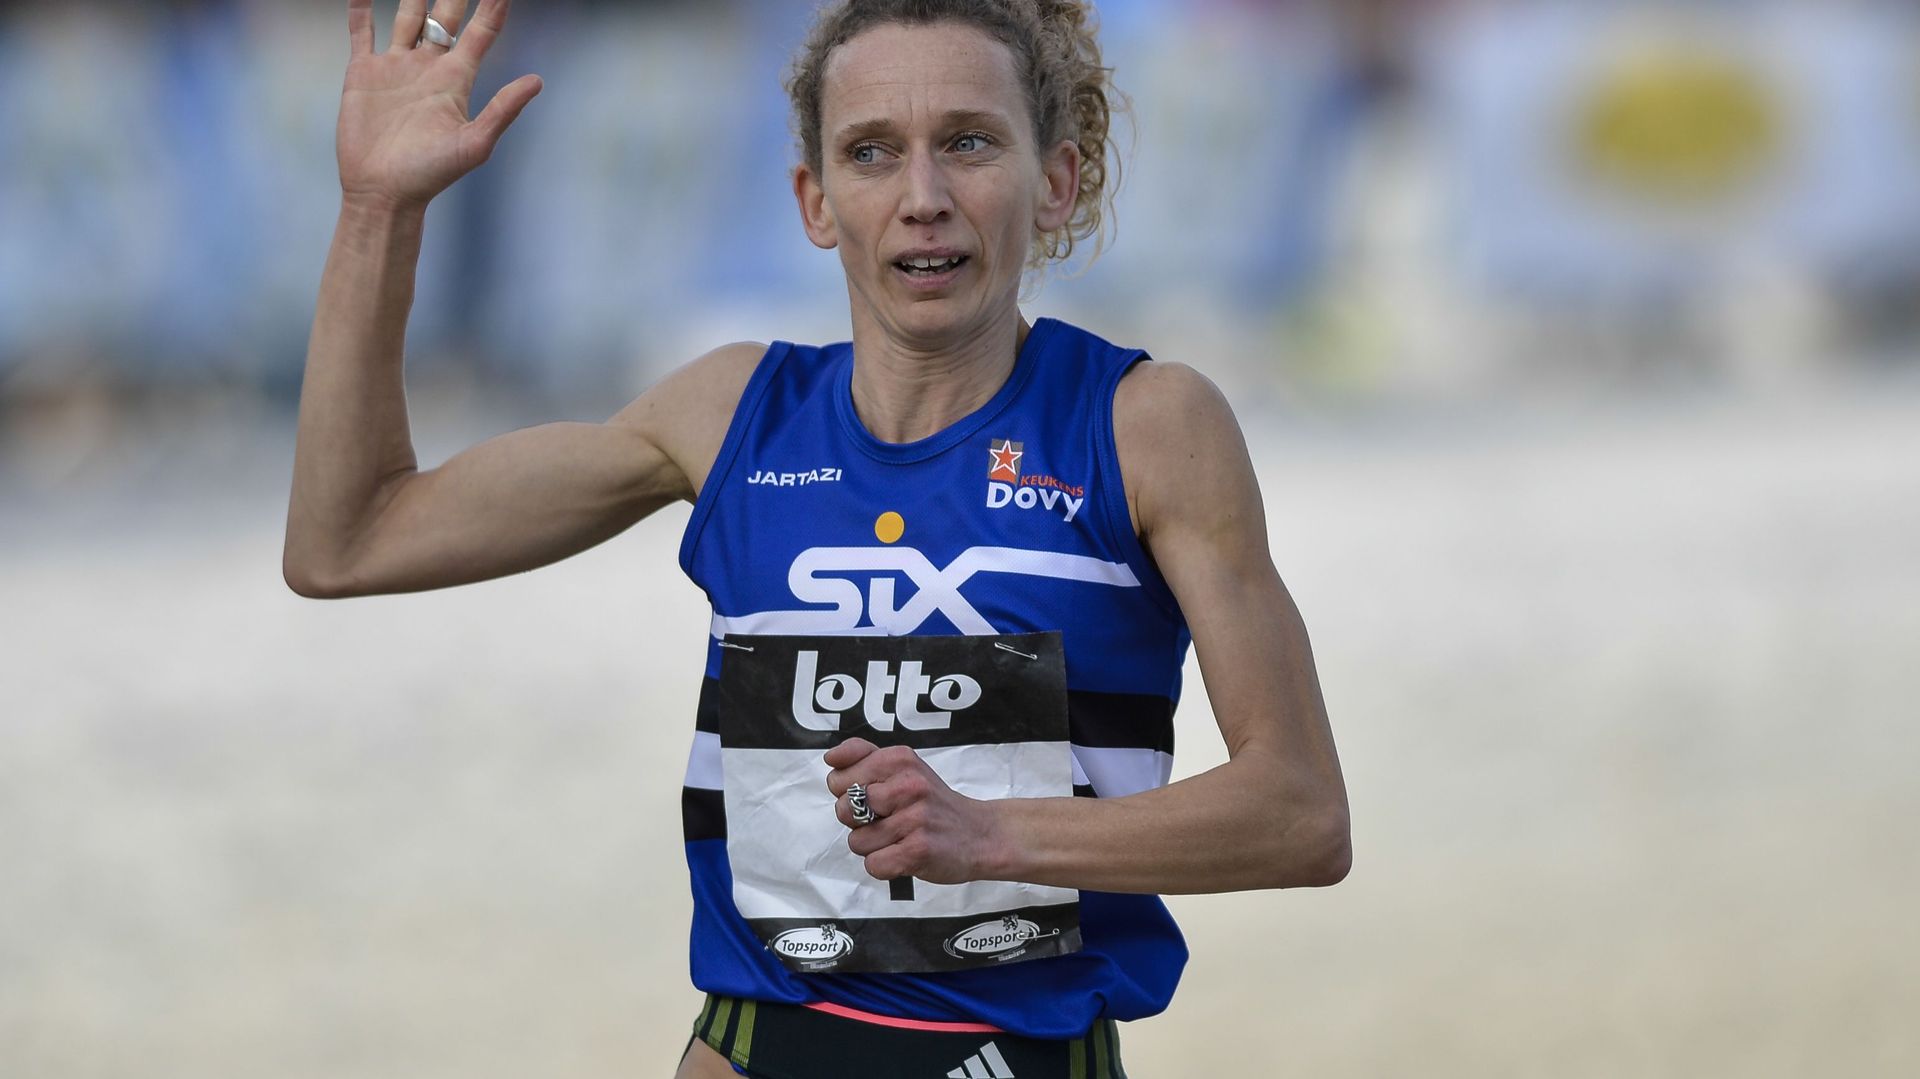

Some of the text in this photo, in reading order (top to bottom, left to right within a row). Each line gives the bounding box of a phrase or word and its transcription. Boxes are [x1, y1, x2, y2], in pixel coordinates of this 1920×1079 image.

[747, 468, 842, 487] JARTAZI
[1020, 475, 1084, 497] KEUKENS
[782, 940, 838, 954] Topsport
[963, 931, 1024, 950] Topspor
